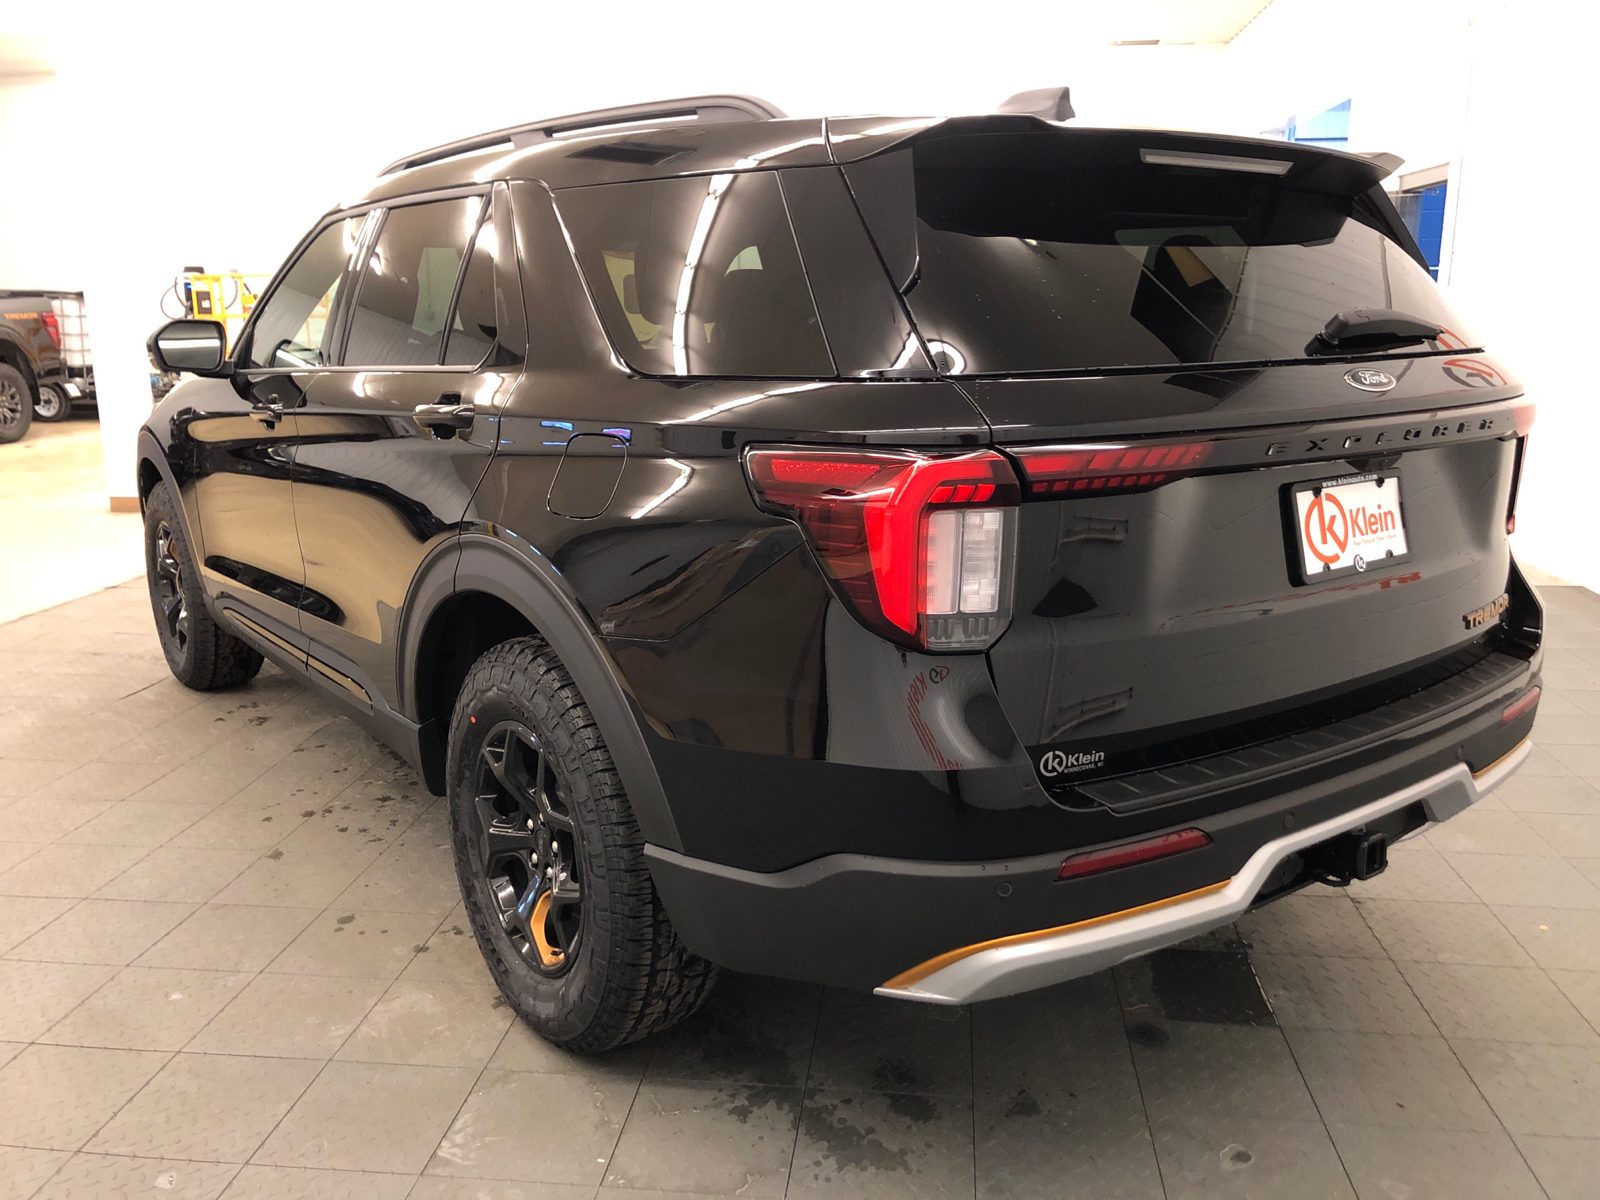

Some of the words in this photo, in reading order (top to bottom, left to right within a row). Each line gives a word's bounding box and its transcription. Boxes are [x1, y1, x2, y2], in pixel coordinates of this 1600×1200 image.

[1359, 371, 1388, 384] Ford
[1264, 418, 1494, 456] EXPLORER
[1321, 474, 1378, 488] www.kleinauto.com
[1348, 503, 1396, 538] Klein
[1462, 593, 1509, 630] TREMOR
[1067, 750, 1104, 766] Klein
